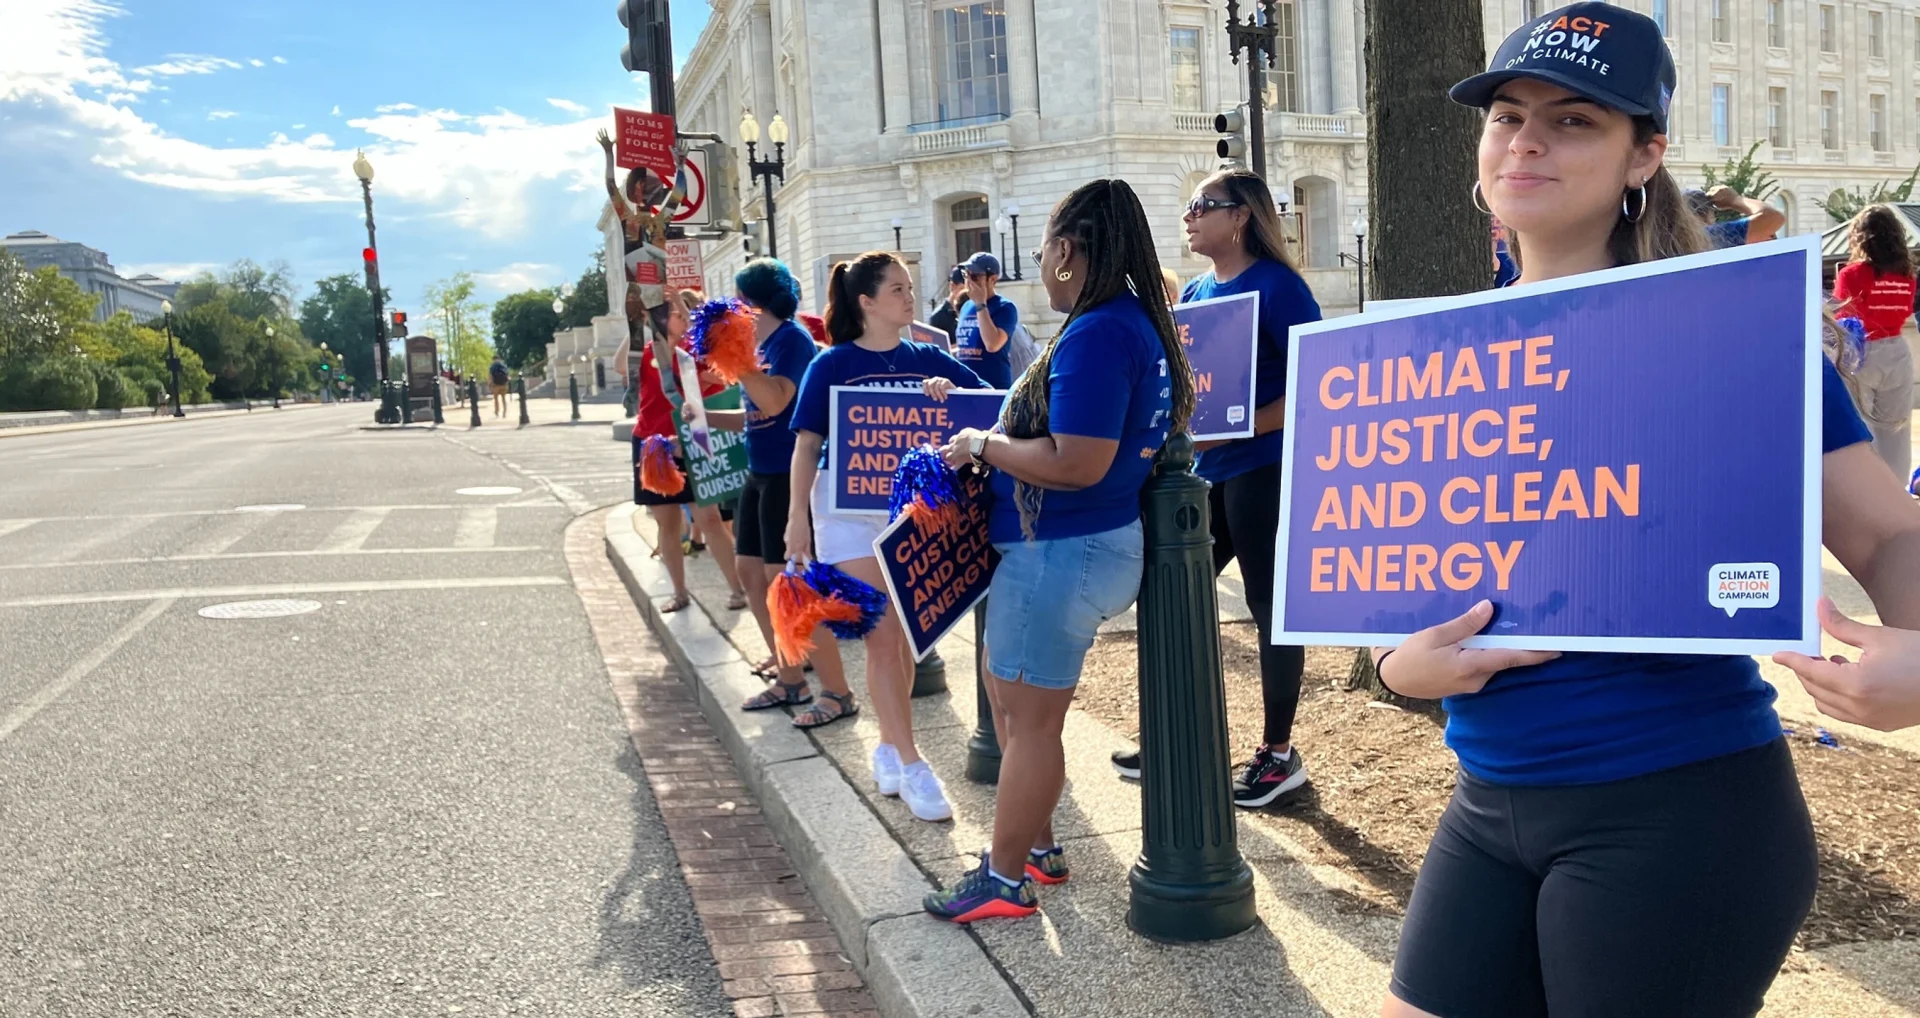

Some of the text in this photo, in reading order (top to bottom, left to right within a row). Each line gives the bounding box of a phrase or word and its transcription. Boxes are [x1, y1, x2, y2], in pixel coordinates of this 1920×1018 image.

[1530, 15, 1610, 37] #ACT
[1522, 31, 1600, 53] NOW
[1505, 48, 1610, 75] ON CLIMATE
[625, 116, 664, 129] MOMS
[625, 125, 665, 140] clean air
[625, 138, 664, 151] FORCE
[665, 244, 689, 256] NOW
[666, 264, 696, 276] OUTE
[1319, 335, 1571, 410] CLIMATE,
[848, 405, 954, 429] CLIMATE,
[1316, 404, 1553, 471] JUSTICE,
[848, 452, 899, 472] AND
[847, 476, 893, 495] ENE
[1312, 464, 1640, 531] AND CLEAN
[914, 522, 990, 612] AND CLE
[1310, 541, 1525, 592] ENERGY
[1718, 570, 1770, 580] CLIMATE
[918, 551, 989, 633] ENERGY
[1718, 581, 1770, 591] ACTION
[1718, 592, 1770, 600] CAMPAIGN
